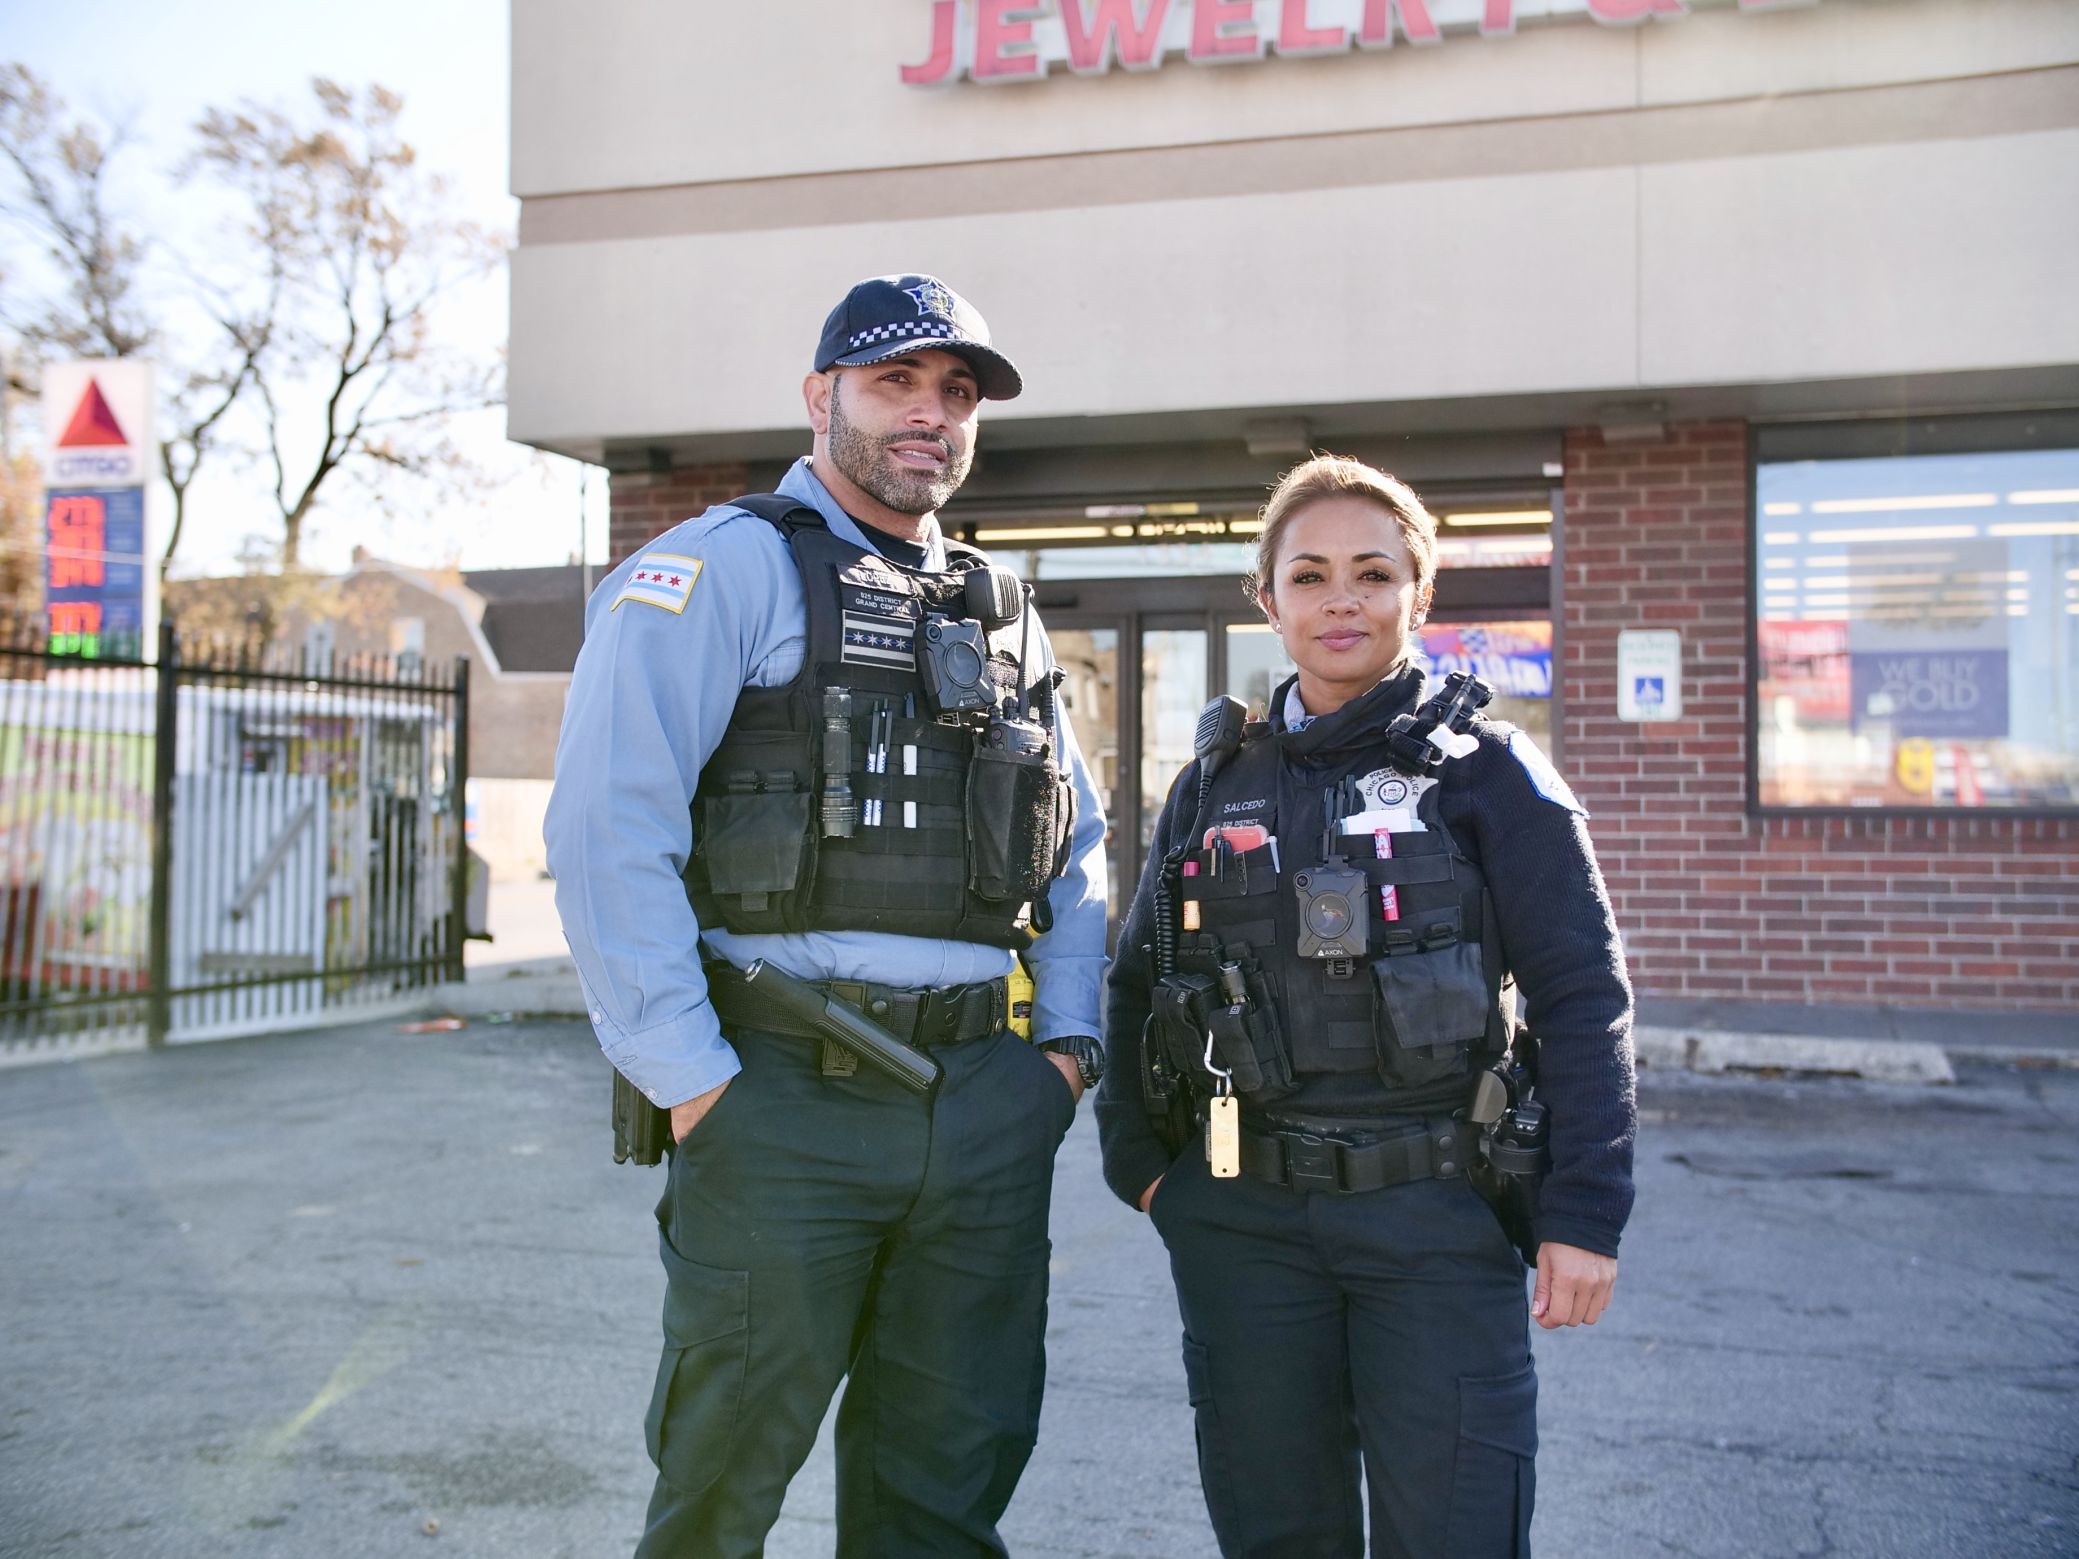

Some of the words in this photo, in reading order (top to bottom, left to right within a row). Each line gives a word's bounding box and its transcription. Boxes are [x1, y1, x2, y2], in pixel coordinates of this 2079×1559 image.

[855, 597, 878, 609] GRAND
[880, 603, 911, 614] CENTRAL
[873, 594, 902, 606] DISTRICT
[1878, 657, 1921, 681] WE
[1880, 679, 1980, 712] GOLD
[1365, 772, 1397, 797] CHICAGO
[1223, 799, 1266, 814] SALCEDO
[1234, 818, 1259, 827] DISTRICT
